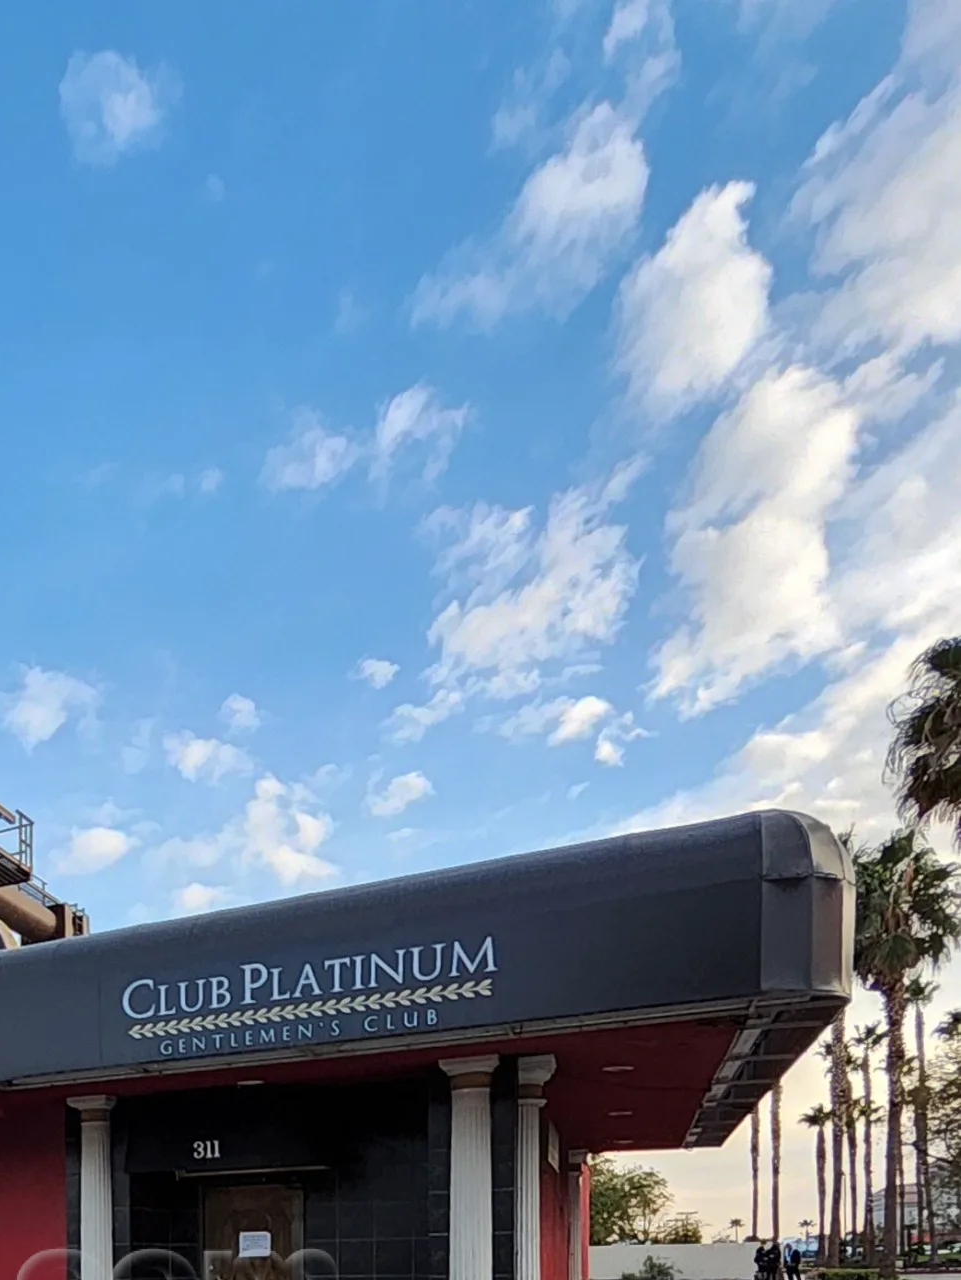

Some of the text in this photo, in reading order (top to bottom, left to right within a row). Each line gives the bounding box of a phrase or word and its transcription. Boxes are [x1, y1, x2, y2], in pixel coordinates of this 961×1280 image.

[122, 935, 499, 1020] CLUB PLATINUM
[159, 1009, 438, 1055] GENTLEMEN'S CLUB
[193, 1139, 221, 1159] 311
